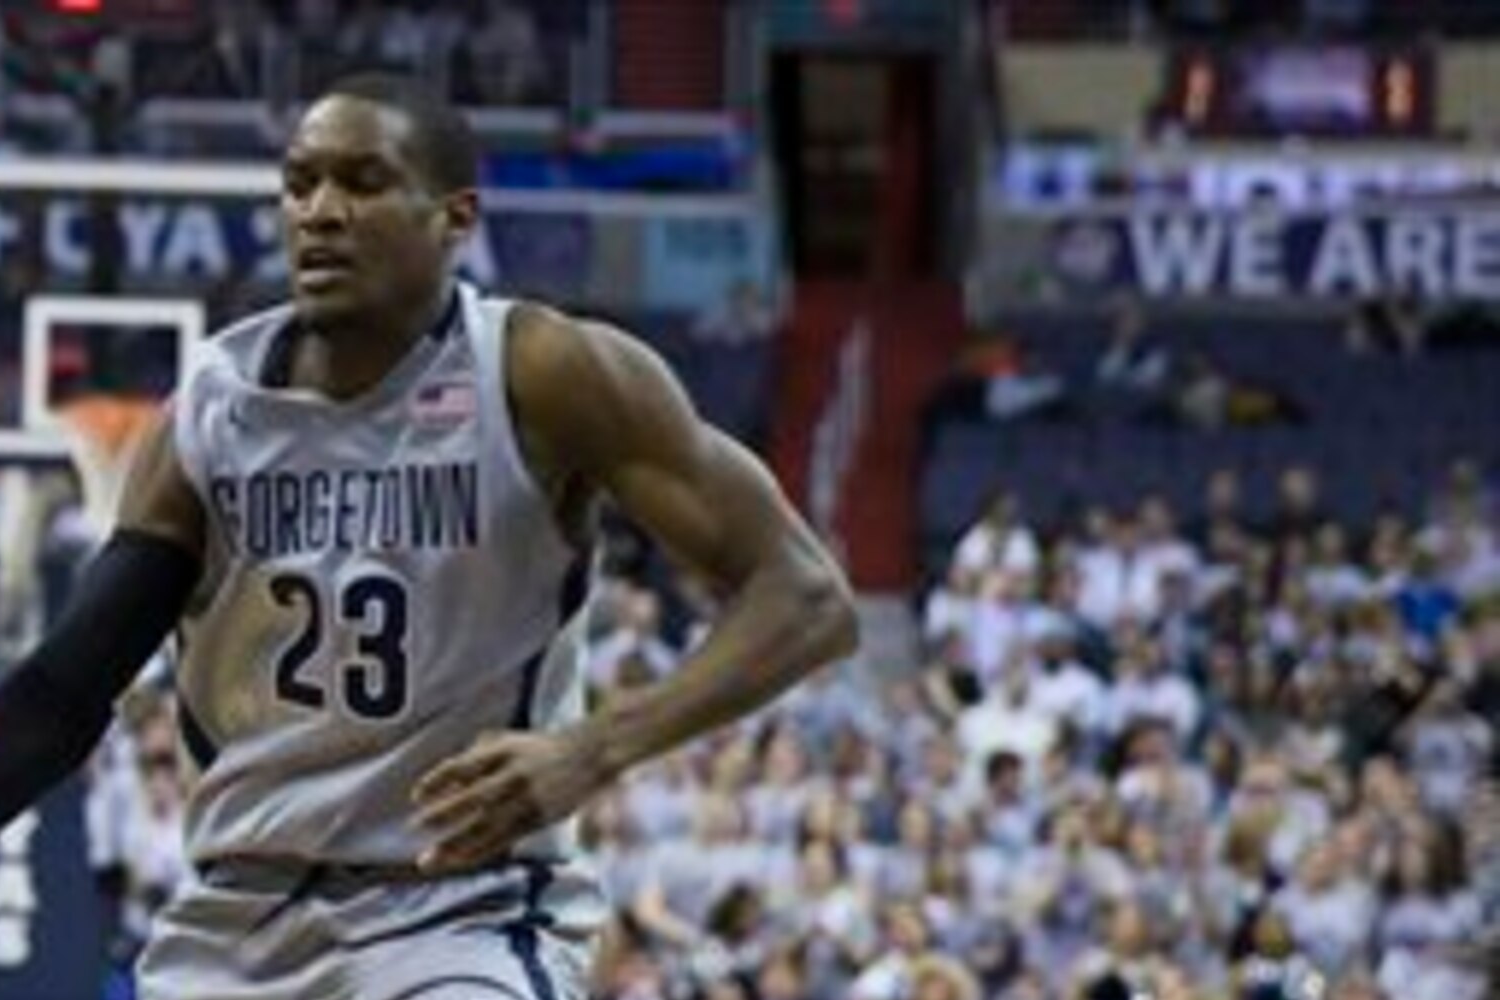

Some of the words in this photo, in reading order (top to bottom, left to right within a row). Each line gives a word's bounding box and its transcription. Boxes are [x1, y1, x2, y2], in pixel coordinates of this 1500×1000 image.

[1130, 212, 1287, 295] WE
[1309, 214, 1500, 299] ARE
[269, 570, 408, 720] 23
